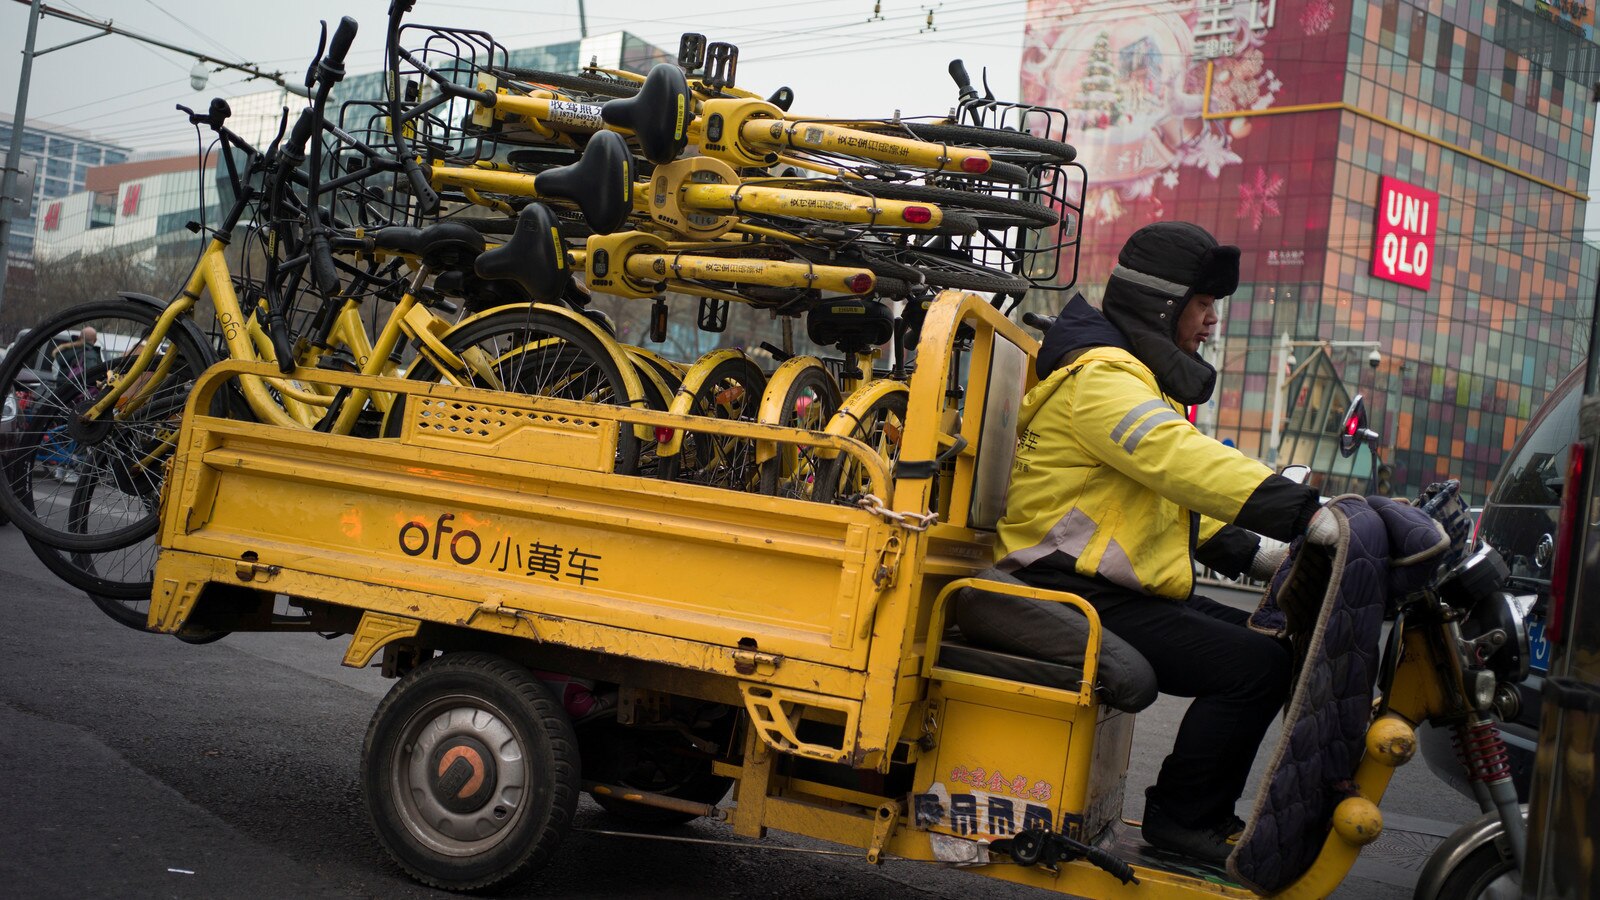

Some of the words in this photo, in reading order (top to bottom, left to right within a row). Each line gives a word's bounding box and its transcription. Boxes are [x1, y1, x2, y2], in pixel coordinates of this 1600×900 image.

[837, 134, 909, 157] 支付宝扫码骑车
[1387, 189, 1429, 236] UNI
[1382, 232, 1428, 276] QLO
[221, 312, 240, 341] ofo
[399, 513, 481, 565] ofo
[489, 537, 601, 585] 小黄车
